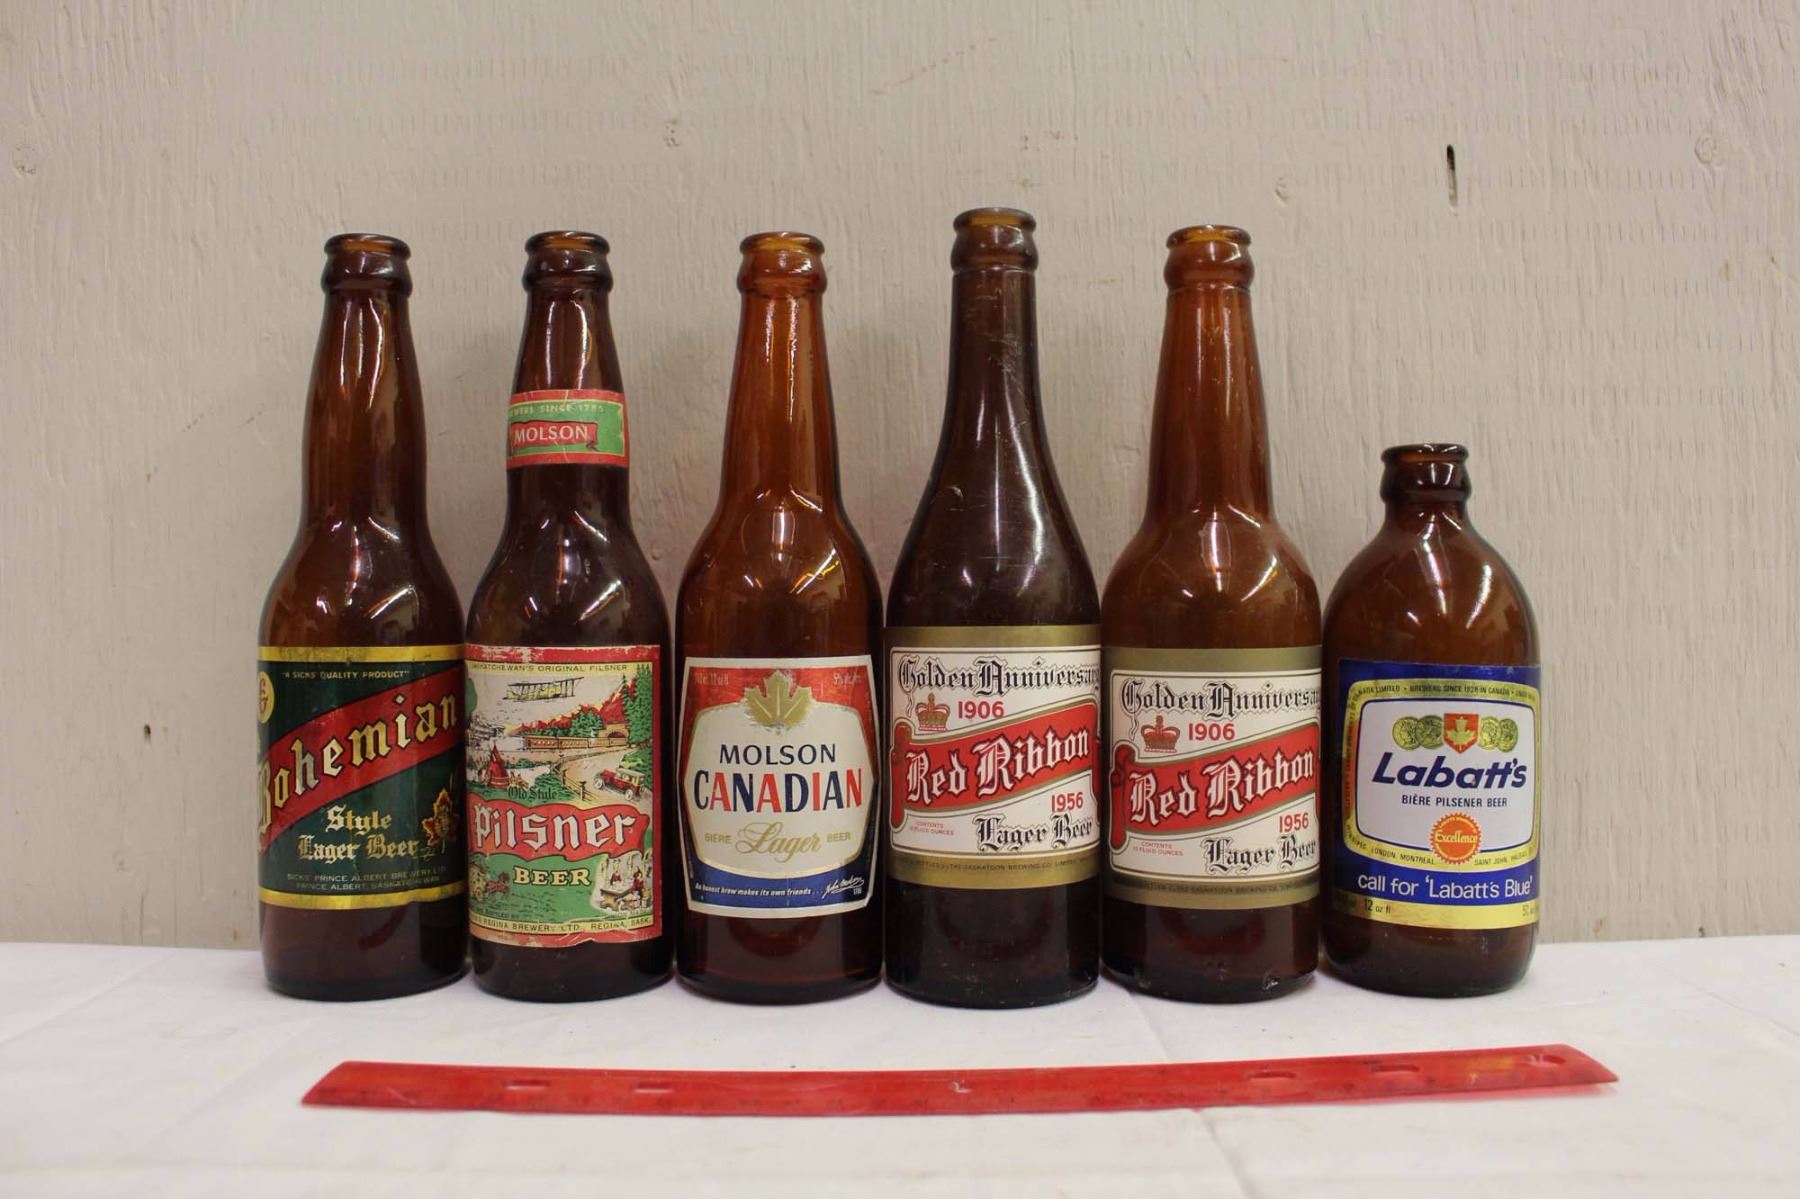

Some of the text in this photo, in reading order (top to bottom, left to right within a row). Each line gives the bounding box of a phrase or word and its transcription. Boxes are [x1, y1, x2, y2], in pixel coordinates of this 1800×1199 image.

[513, 425, 588, 446] MOLSON
[319, 671, 359, 680] QUALITY
[537, 664, 585, 672] ORIGINAL
[589, 663, 628, 672] PILSNER
[900, 656, 974, 692] Golden
[1121, 679, 1205, 714] Golden
[1443, 685, 1462, 693] SINCE
[1487, 687, 1510, 695] CANADA
[958, 700, 1005, 719] 1906
[1187, 723, 1236, 741] 1906
[719, 743, 836, 766] MOLSON
[904, 726, 1089, 806] Red Ribbon
[1371, 750, 1527, 789] Labatt's
[508, 785, 558, 802] Old Style
[693, 768, 863, 813] CANADIAN
[1129, 770, 1198, 826] Red
[1201, 747, 1314, 818] Ribbon
[1051, 791, 1084, 813] 1956
[1401, 793, 1507, 808] BIÈRE PILSENER BEER
[325, 804, 393, 836] Style
[473, 803, 639, 852] Pilsner
[1279, 812, 1309, 833] 1956
[735, 821, 822, 864] Lager
[827, 831, 852, 843] BEER
[973, 812, 1094, 852] Lager Beer
[297, 833, 420, 865] Lager Beer
[1141, 841, 1173, 849] CONTENTS
[1200, 835, 1317, 874] Lager Beer
[1370, 847, 1396, 859] LONDON
[1400, 853, 1435, 865] MONTREAL
[314, 874, 348, 883] PRINCE
[513, 866, 592, 886] BEER
[1358, 875, 1386, 892] call
[1390, 877, 1419, 896] for
[721, 885, 737, 894] brew
[737, 887, 759, 896] makes
[759, 887, 769, 896] its
[769, 888, 787, 896] own
[1364, 898, 1374, 911] 12
[1375, 905, 1383, 913] oz
[483, 918, 509, 929] REGINA
